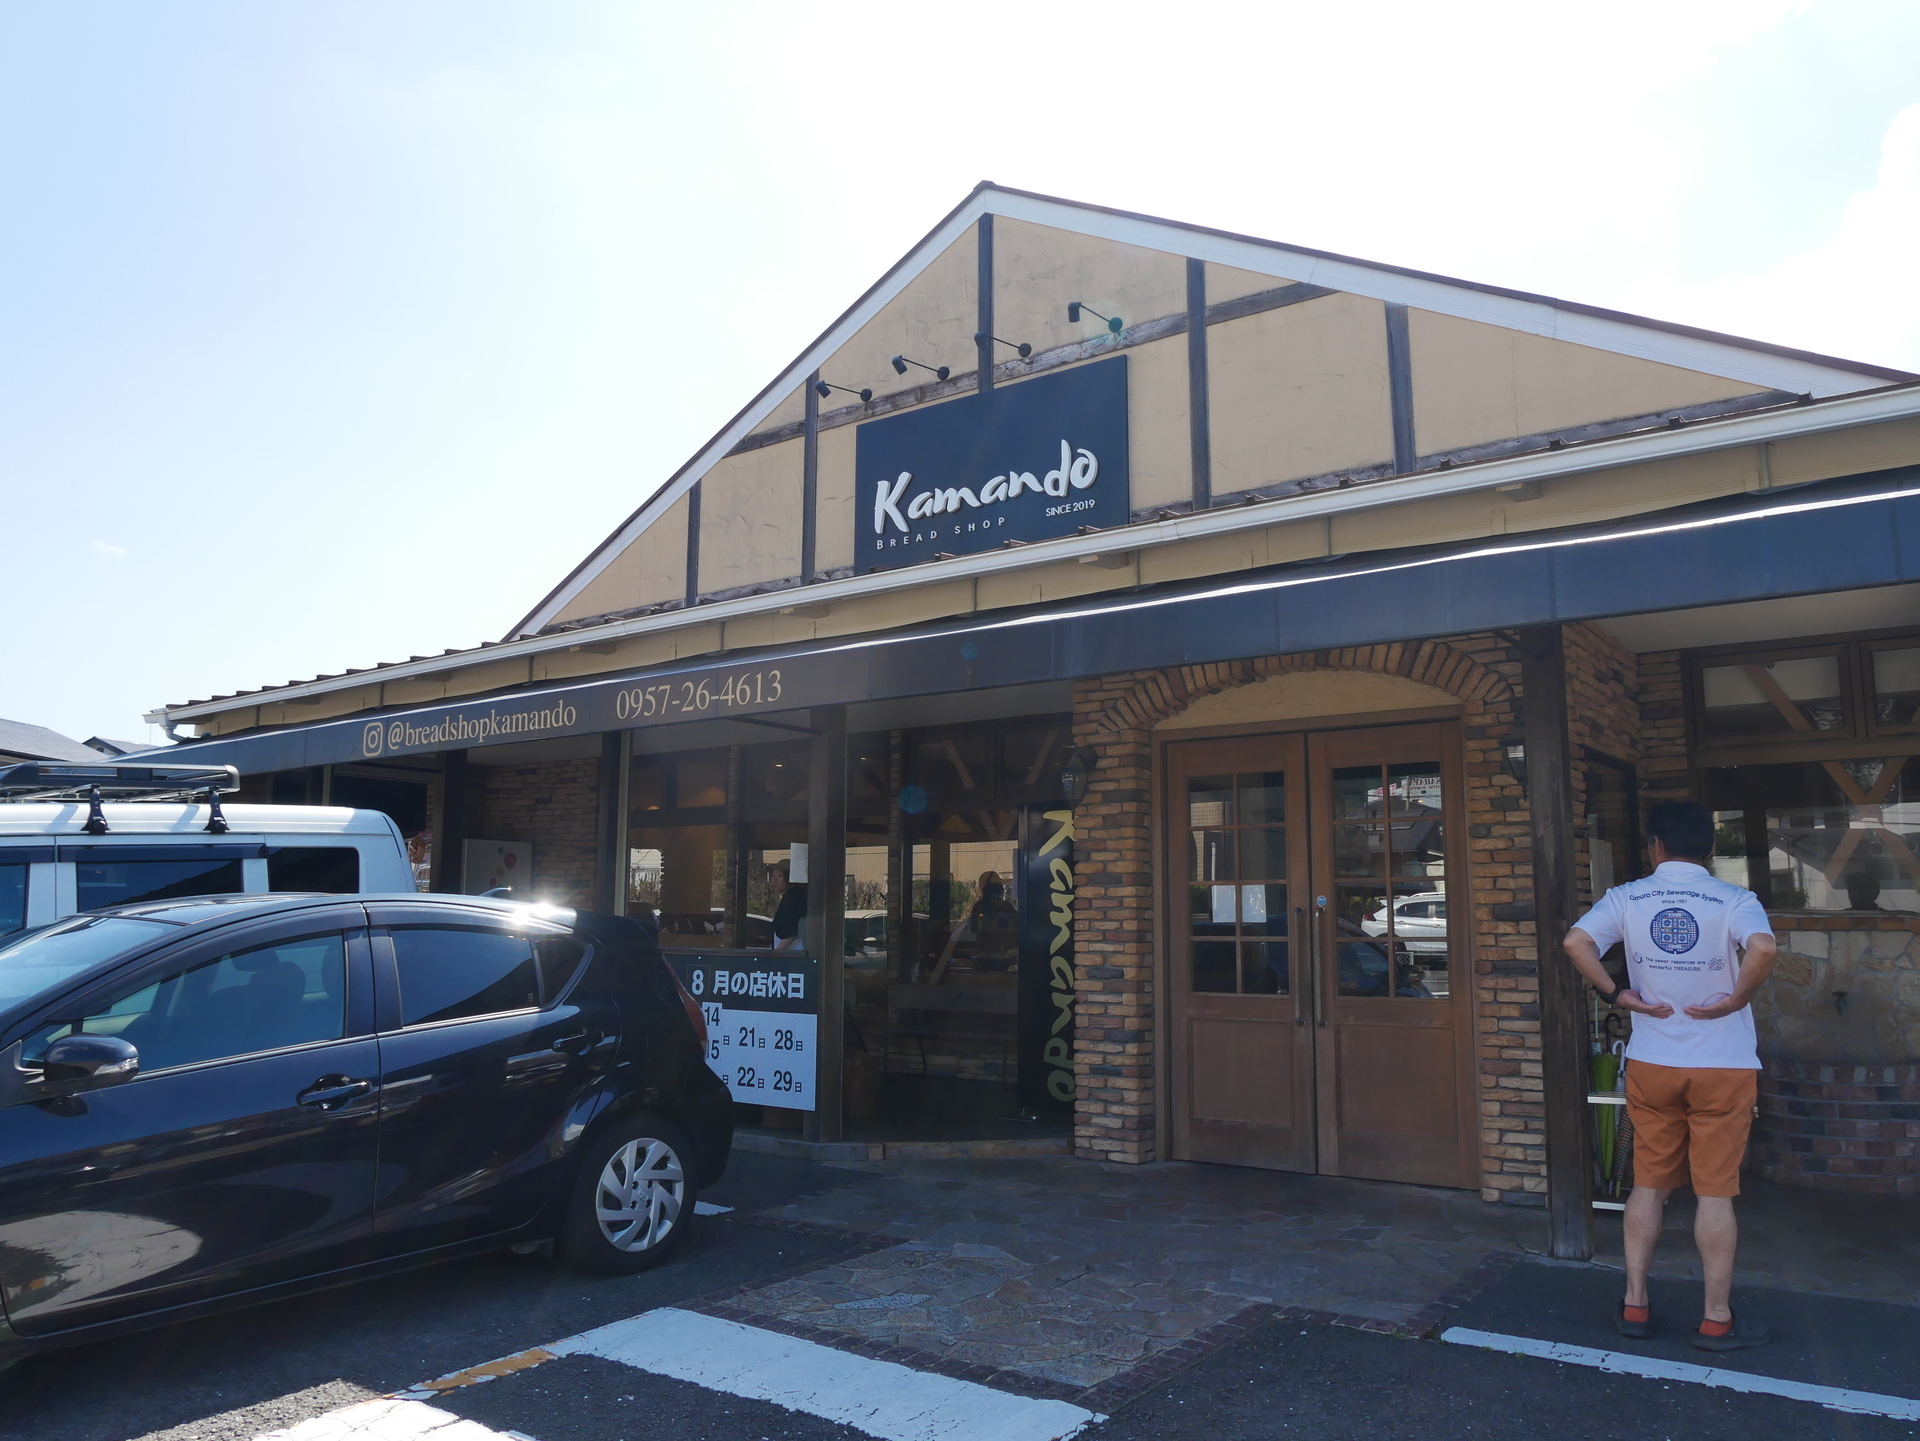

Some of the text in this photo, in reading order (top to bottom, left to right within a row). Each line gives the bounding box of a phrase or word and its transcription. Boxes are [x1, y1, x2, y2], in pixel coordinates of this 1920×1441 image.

[874, 439, 1099, 534] Kamando
[1045, 499, 1096, 517] SINCE 2019
[876, 517, 1006, 550] BREAD SHOP
[616, 669, 782, 721] 0957-26-4613
[387, 699, 577, 750] @breadshopkamando
[1629, 893, 1651, 901] Omura
[1666, 890, 1700, 898] Sewerage
[1700, 893, 1724, 905] System
